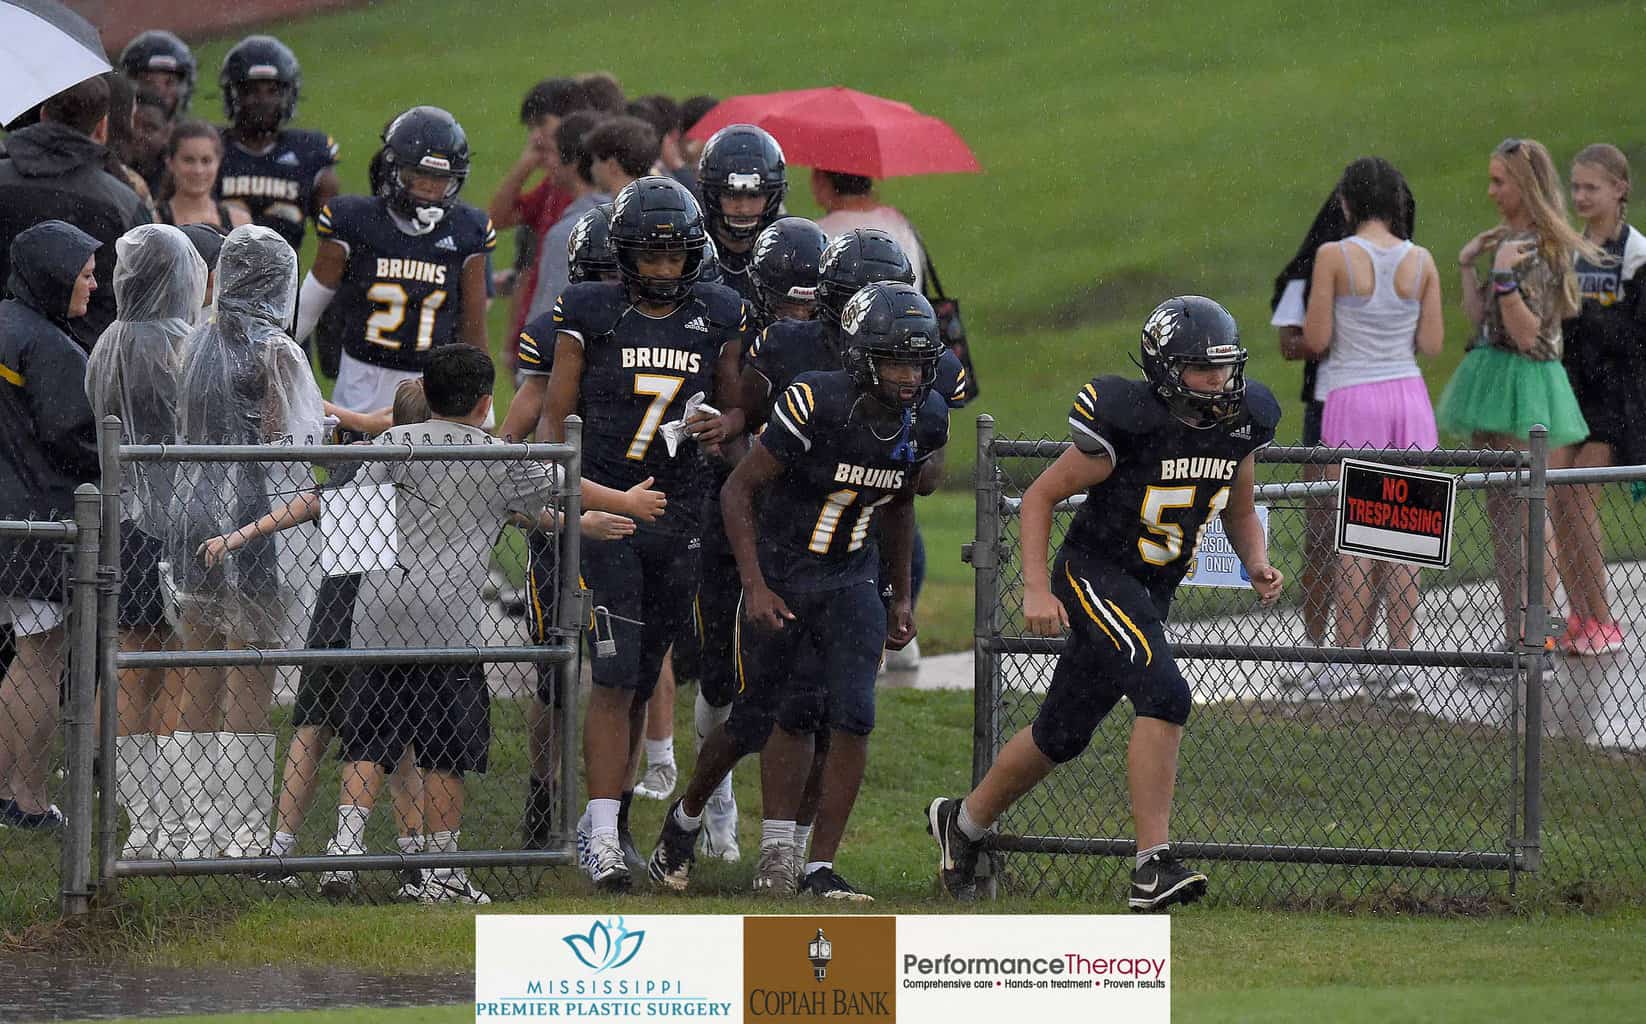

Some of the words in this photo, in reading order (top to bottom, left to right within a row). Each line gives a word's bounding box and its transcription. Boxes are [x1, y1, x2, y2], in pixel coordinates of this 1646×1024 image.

[222, 176, 299, 200] BRUINS
[376, 258, 447, 284] BRUINS
[364, 283, 447, 351] 21
[621, 347, 702, 374] BRUINS
[625, 373, 686, 461] 7
[834, 462, 905, 490] BRUINS
[1161, 457, 1237, 480] BRUINS
[1382, 477, 1408, 503] NO
[808, 488, 895, 556] 11
[1137, 485, 1232, 567] 51
[1347, 497, 1443, 535] TRESPASSING
[1206, 556, 1235, 573] ONLY
